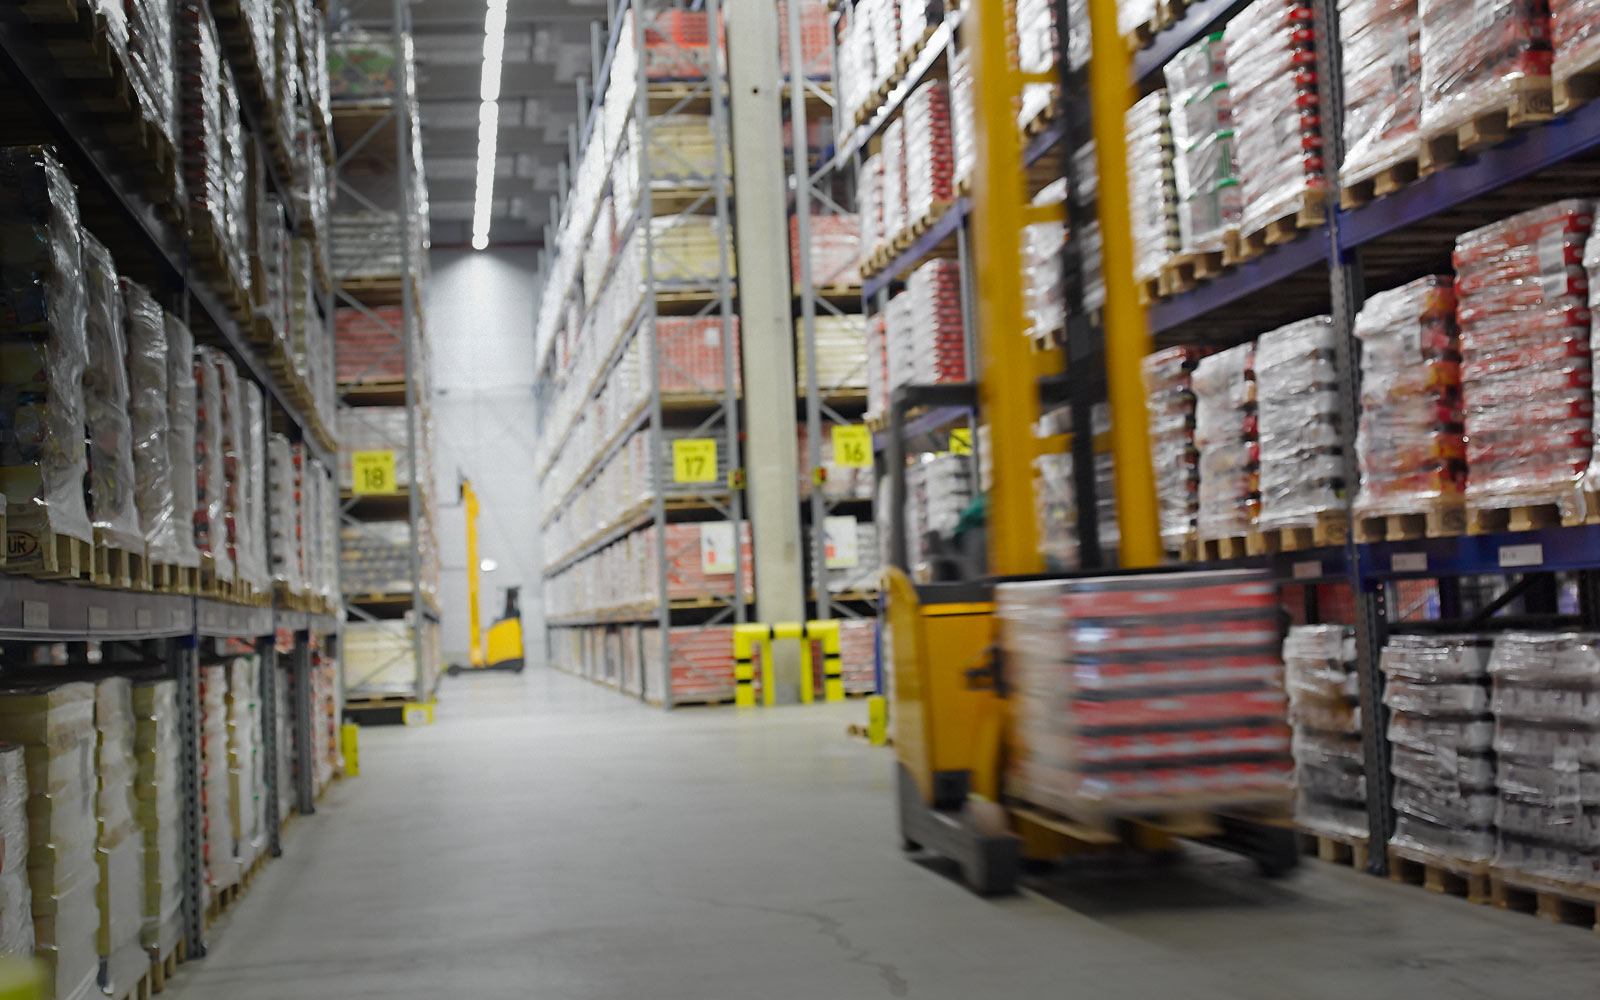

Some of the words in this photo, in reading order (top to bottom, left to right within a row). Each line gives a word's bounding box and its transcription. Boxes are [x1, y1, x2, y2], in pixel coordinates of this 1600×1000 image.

[843, 442, 865, 462] 16
[684, 455, 705, 477] 17
[363, 466, 385, 489] 18
[8, 535, 26, 553] UR
